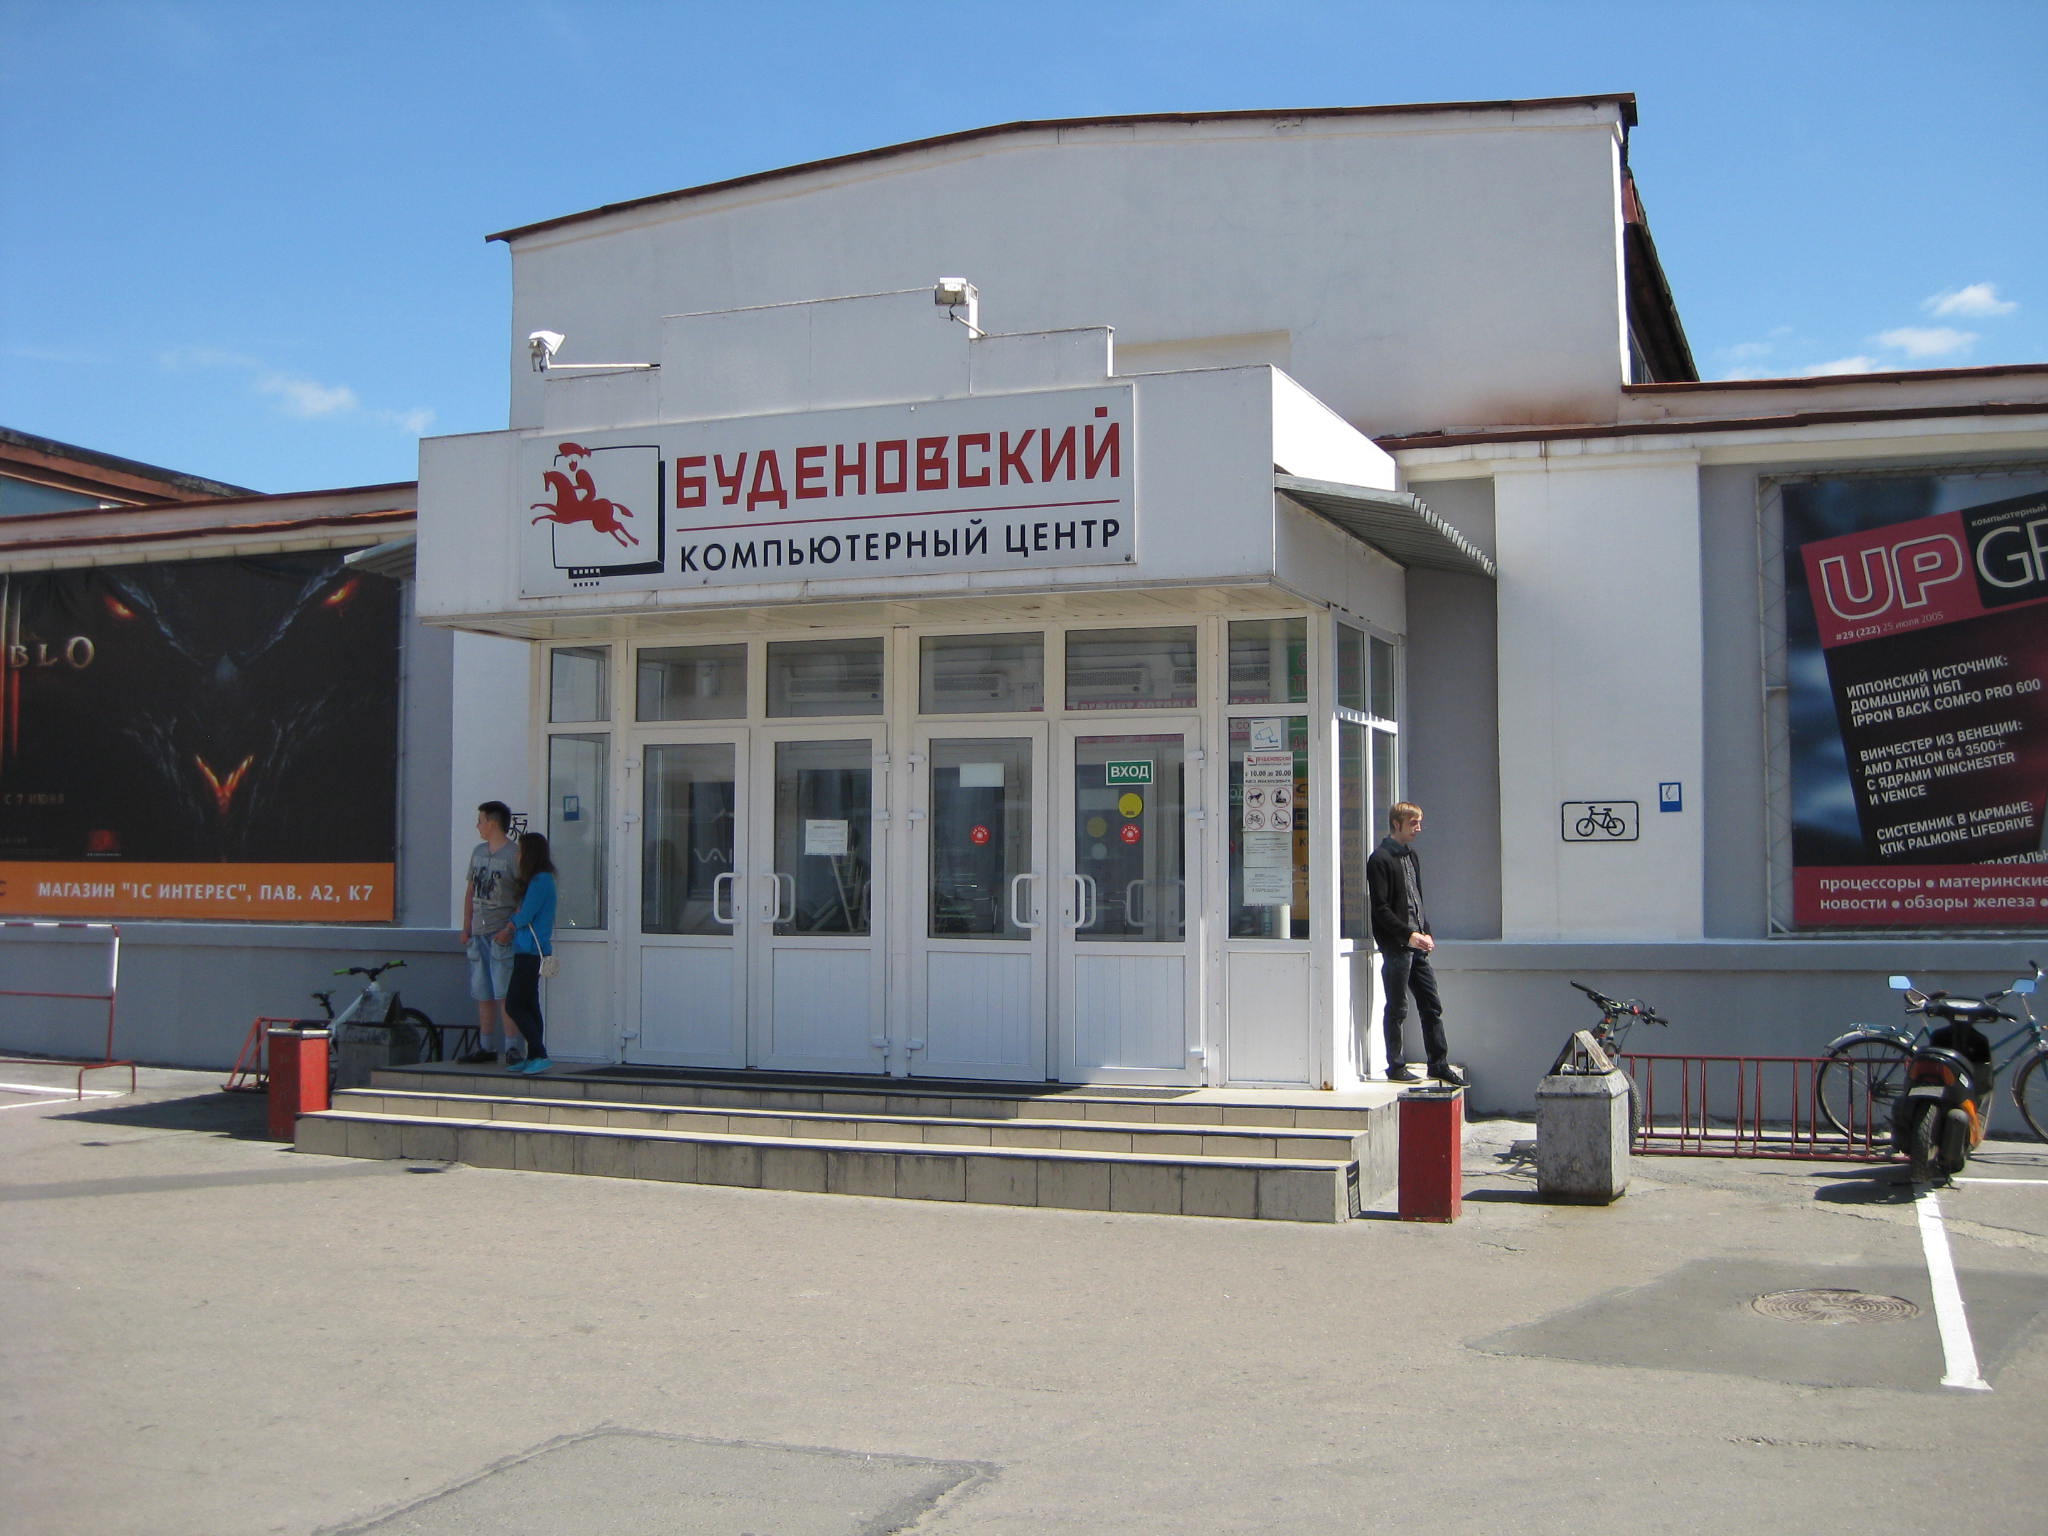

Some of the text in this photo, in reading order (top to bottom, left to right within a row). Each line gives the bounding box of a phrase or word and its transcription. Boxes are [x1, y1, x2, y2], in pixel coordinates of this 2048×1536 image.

[676, 406, 1121, 512] БУДЕНОВСКИЙ
[681, 518, 1120, 573] КОМПЬЮТЕРНЫЙ ЦЕНТР
[1819, 533, 1963, 621] UP
[1856, 625, 1881, 639] (222)
[1846, 655, 2008, 698] ИППОНСКИЙ ИСТОЧНИК:
[1851, 679, 1961, 714] ДОМАШНИЙ ИБП
[1853, 678, 2041, 727] IPPON BACK COMFO PRO 600
[1860, 720, 2023, 762] ВИНЧЕСТЕР ИЗ ВЕНЕЦИИ:
[1864, 739, 2006, 776] AMD ATHLON 64 3500+
[1110, 764, 1150, 780] ВХОД
[1878, 768, 1932, 789] ЯДРАМИ
[1935, 751, 2016, 777] WINCHESTER
[1870, 784, 1927, 806] И VENICE
[1876, 801, 2034, 840] СИСТЕМНИК В КАРМАНЕ:
[1880, 815, 2034, 856] КПК PALMONE LIFEDRIVE
[39, 882, 116, 898] МАГАЗИН
[159, 883, 253, 902] ИНТЕРЕС",
[260, 884, 303, 901] ПАВ.
[1820, 875, 2048, 892] процессоры материнские
[1820, 894, 2035, 911] новости обзоры железа
